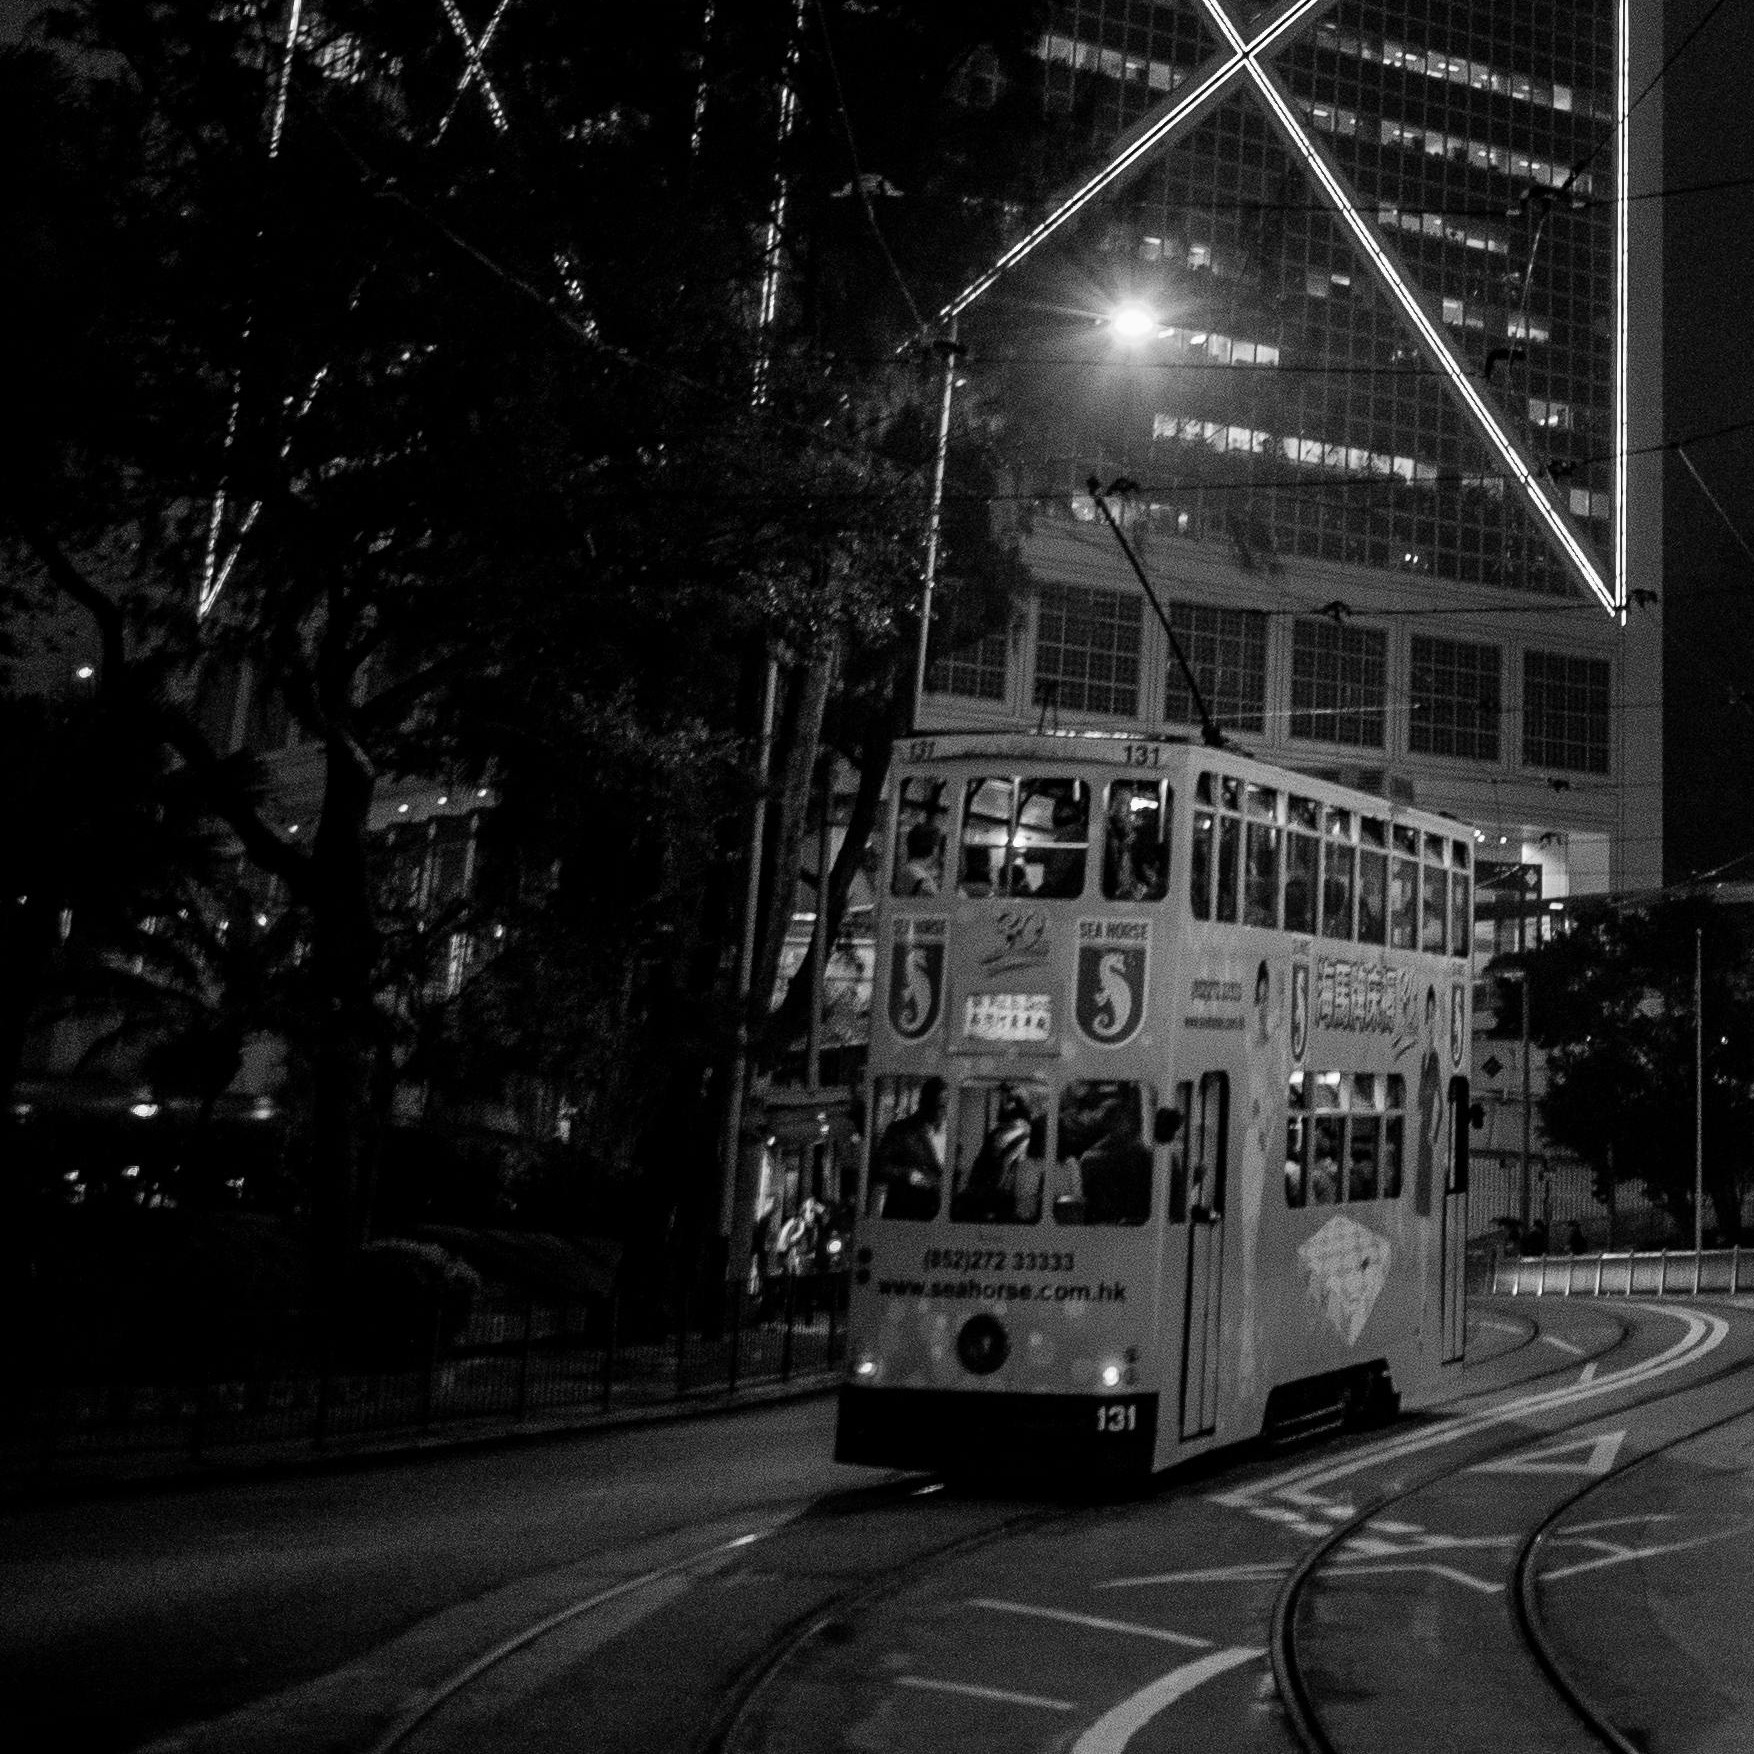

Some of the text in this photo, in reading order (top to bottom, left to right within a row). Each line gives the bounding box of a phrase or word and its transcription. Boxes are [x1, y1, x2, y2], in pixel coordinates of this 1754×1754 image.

[1123, 744, 1161, 767] 131
[1079, 921, 1149, 940] SEA HORSE
[1012, 1251, 1075, 1272] 33333
[878, 1278, 1127, 1302] www.seahorse.com.hk
[1096, 1403, 1137, 1433] 131
